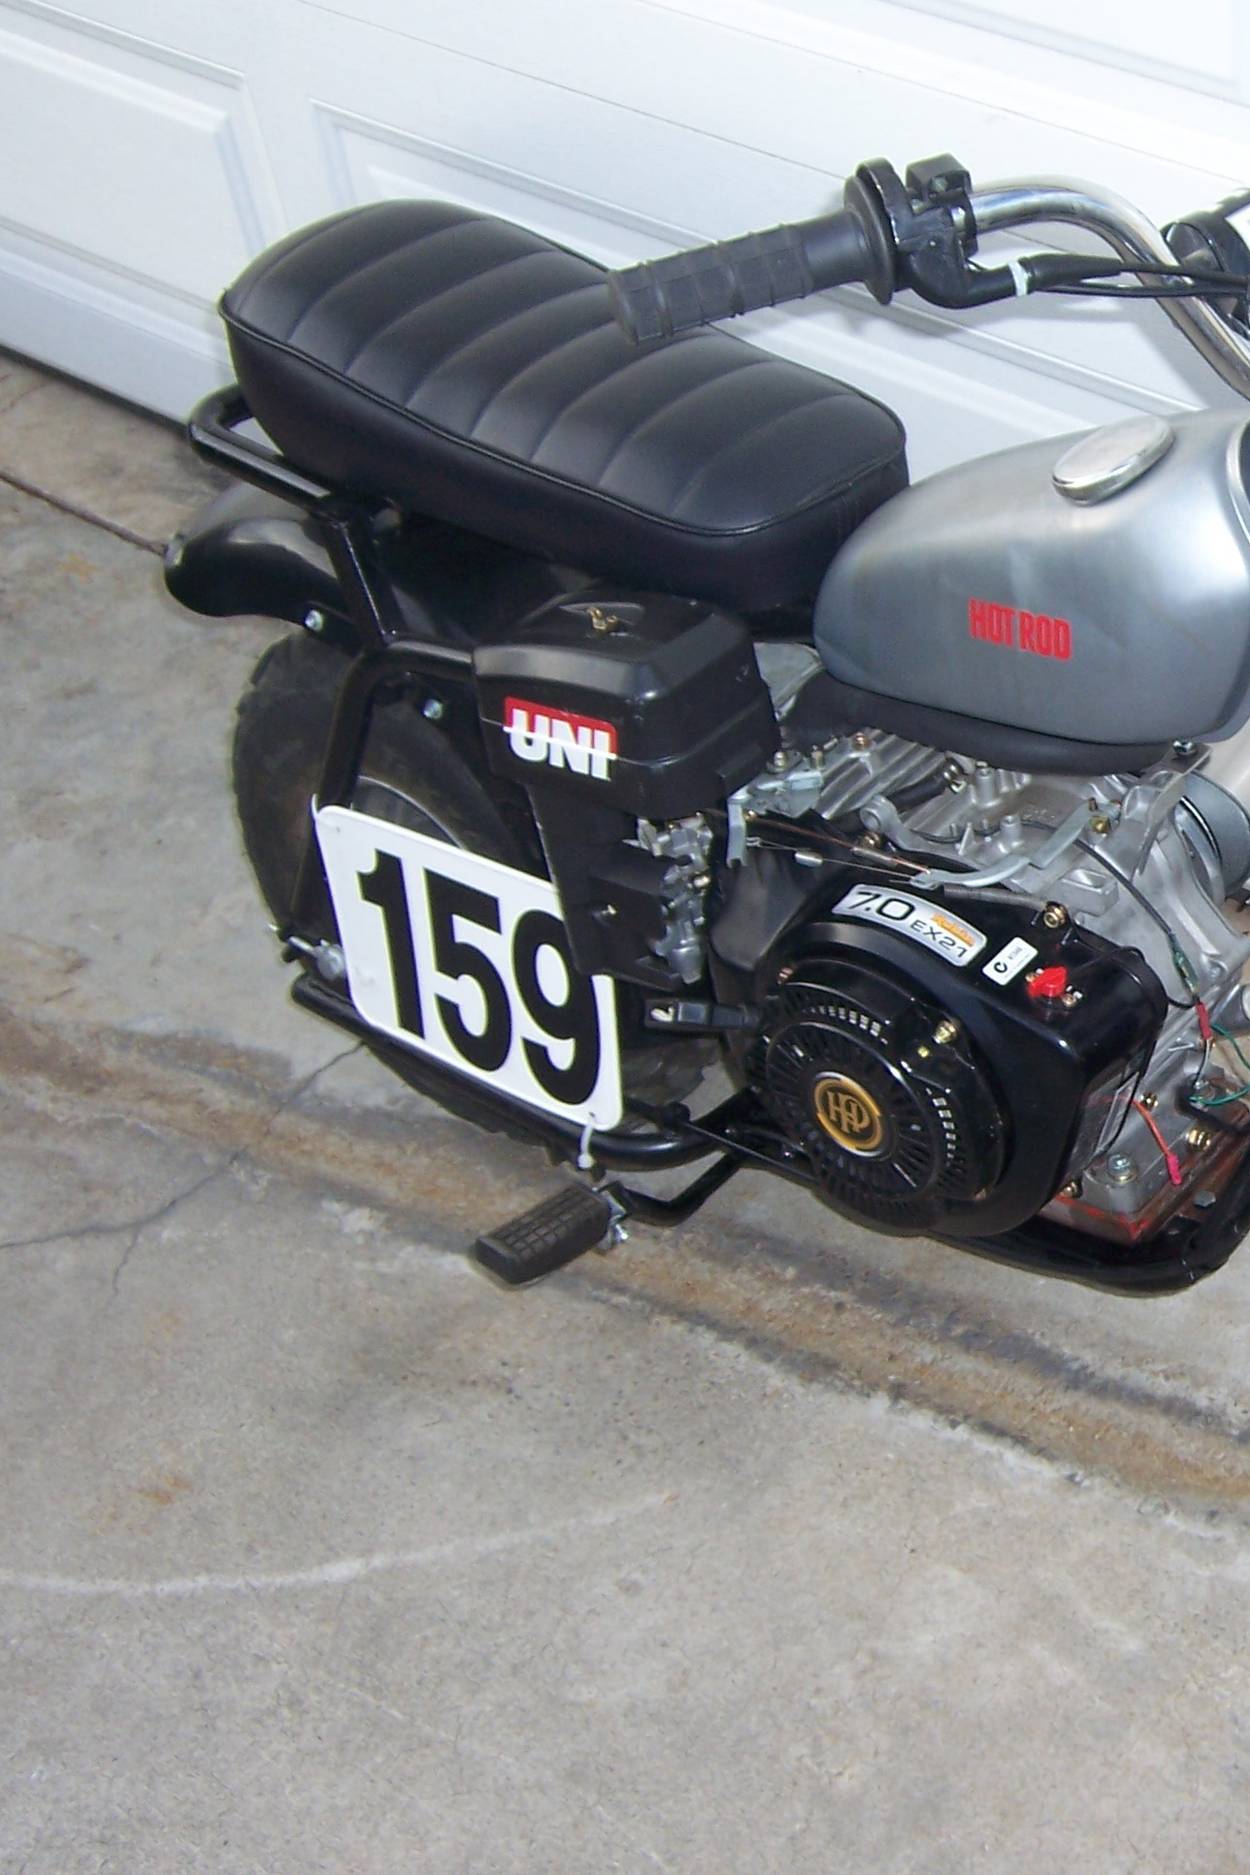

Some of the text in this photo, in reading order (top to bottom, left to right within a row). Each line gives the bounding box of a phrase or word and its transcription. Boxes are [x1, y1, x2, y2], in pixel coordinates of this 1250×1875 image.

[968, 598, 1071, 662] HOT ROD
[508, 707, 613, 781] UNI
[848, 891, 916, 921] 7.0
[910, 919, 969, 958] EX21
[355, 848, 600, 1105] 159
